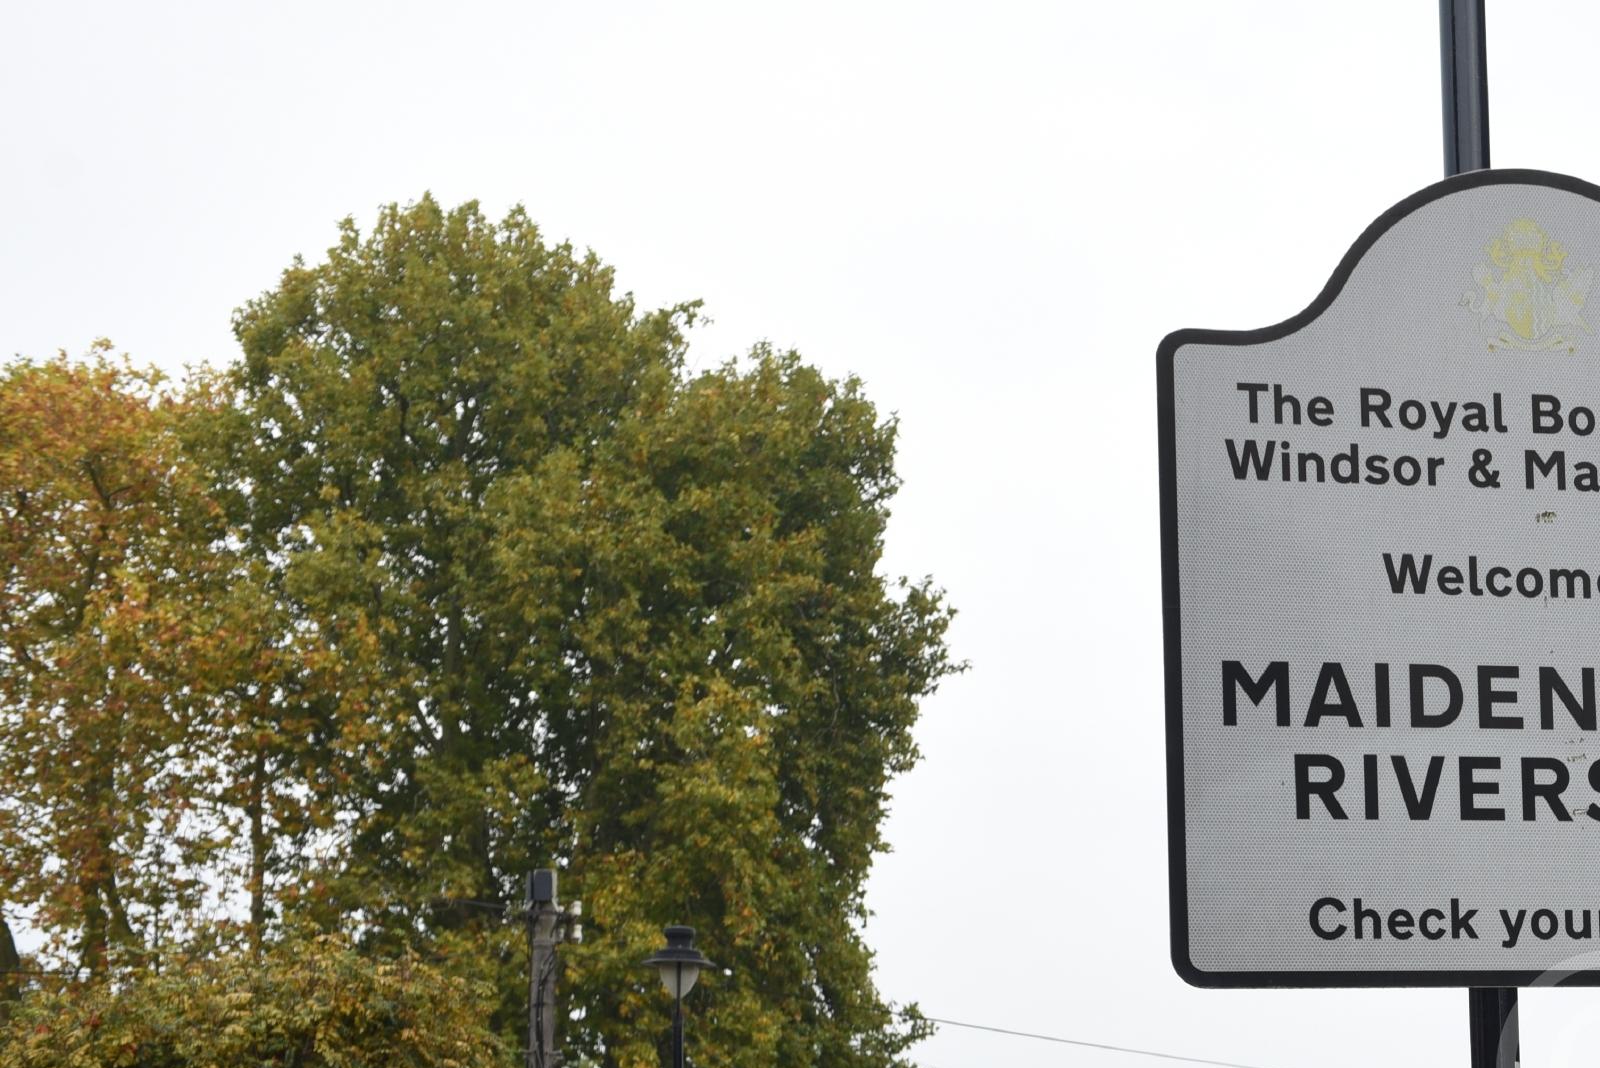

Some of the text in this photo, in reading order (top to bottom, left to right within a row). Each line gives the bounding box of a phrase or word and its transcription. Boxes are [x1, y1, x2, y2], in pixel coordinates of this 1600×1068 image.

[1236, 382, 1335, 427] The
[1360, 387, 1508, 440] Royal
[1225, 438, 1447, 487] Windsor
[1468, 448, 1501, 489] &
[1308, 896, 1479, 941] Check
